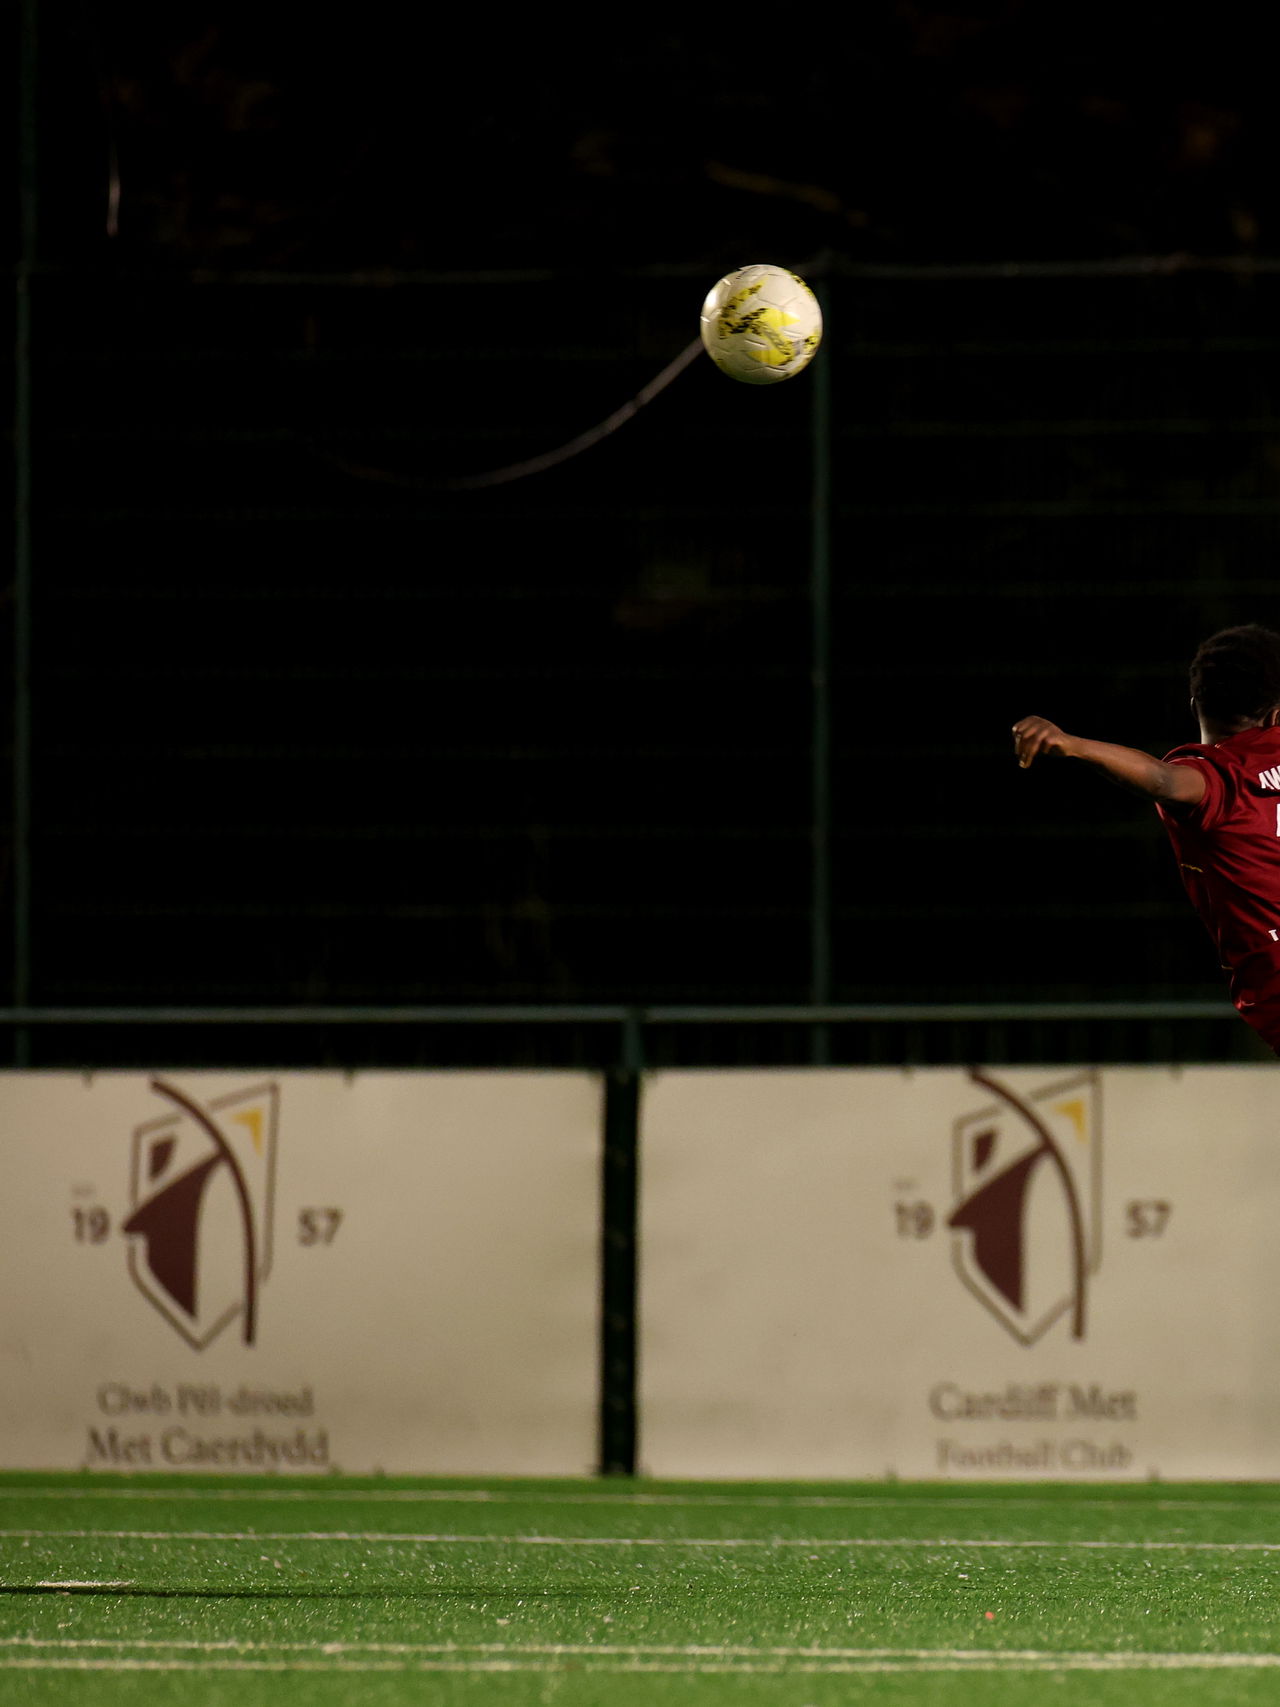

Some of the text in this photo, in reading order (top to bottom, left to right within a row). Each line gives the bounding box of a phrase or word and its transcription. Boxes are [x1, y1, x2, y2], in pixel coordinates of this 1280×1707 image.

[73, 1206, 343, 1246] 19 57
[895, 1200, 1171, 1240] 19 57
[929, 1382, 1138, 1422] Cardiff Met
[87, 1427, 152, 1465] Met
[936, 1437, 1134, 1469] Football Club
